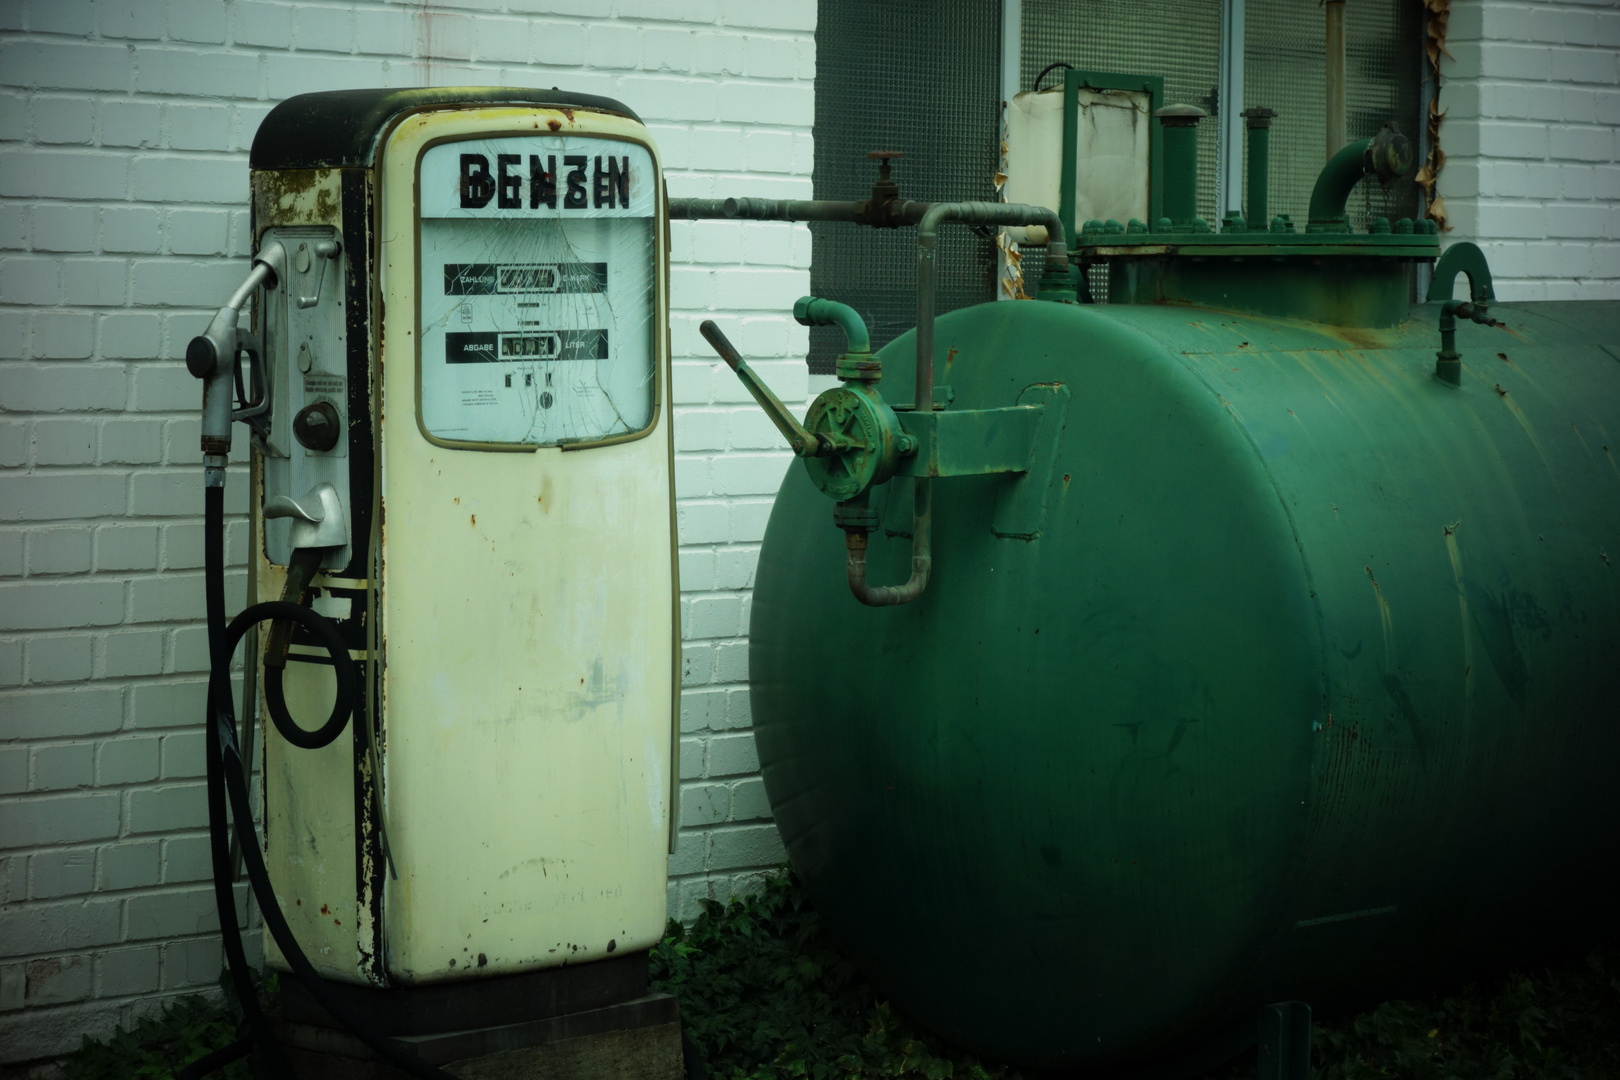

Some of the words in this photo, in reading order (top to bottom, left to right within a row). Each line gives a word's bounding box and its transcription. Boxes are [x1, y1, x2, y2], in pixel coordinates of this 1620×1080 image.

[460, 154, 629, 209] BENZIN
[459, 275, 495, 284] ZAHLUNG
[463, 343, 494, 352] ABGABE
[565, 341, 585, 349] LITER
